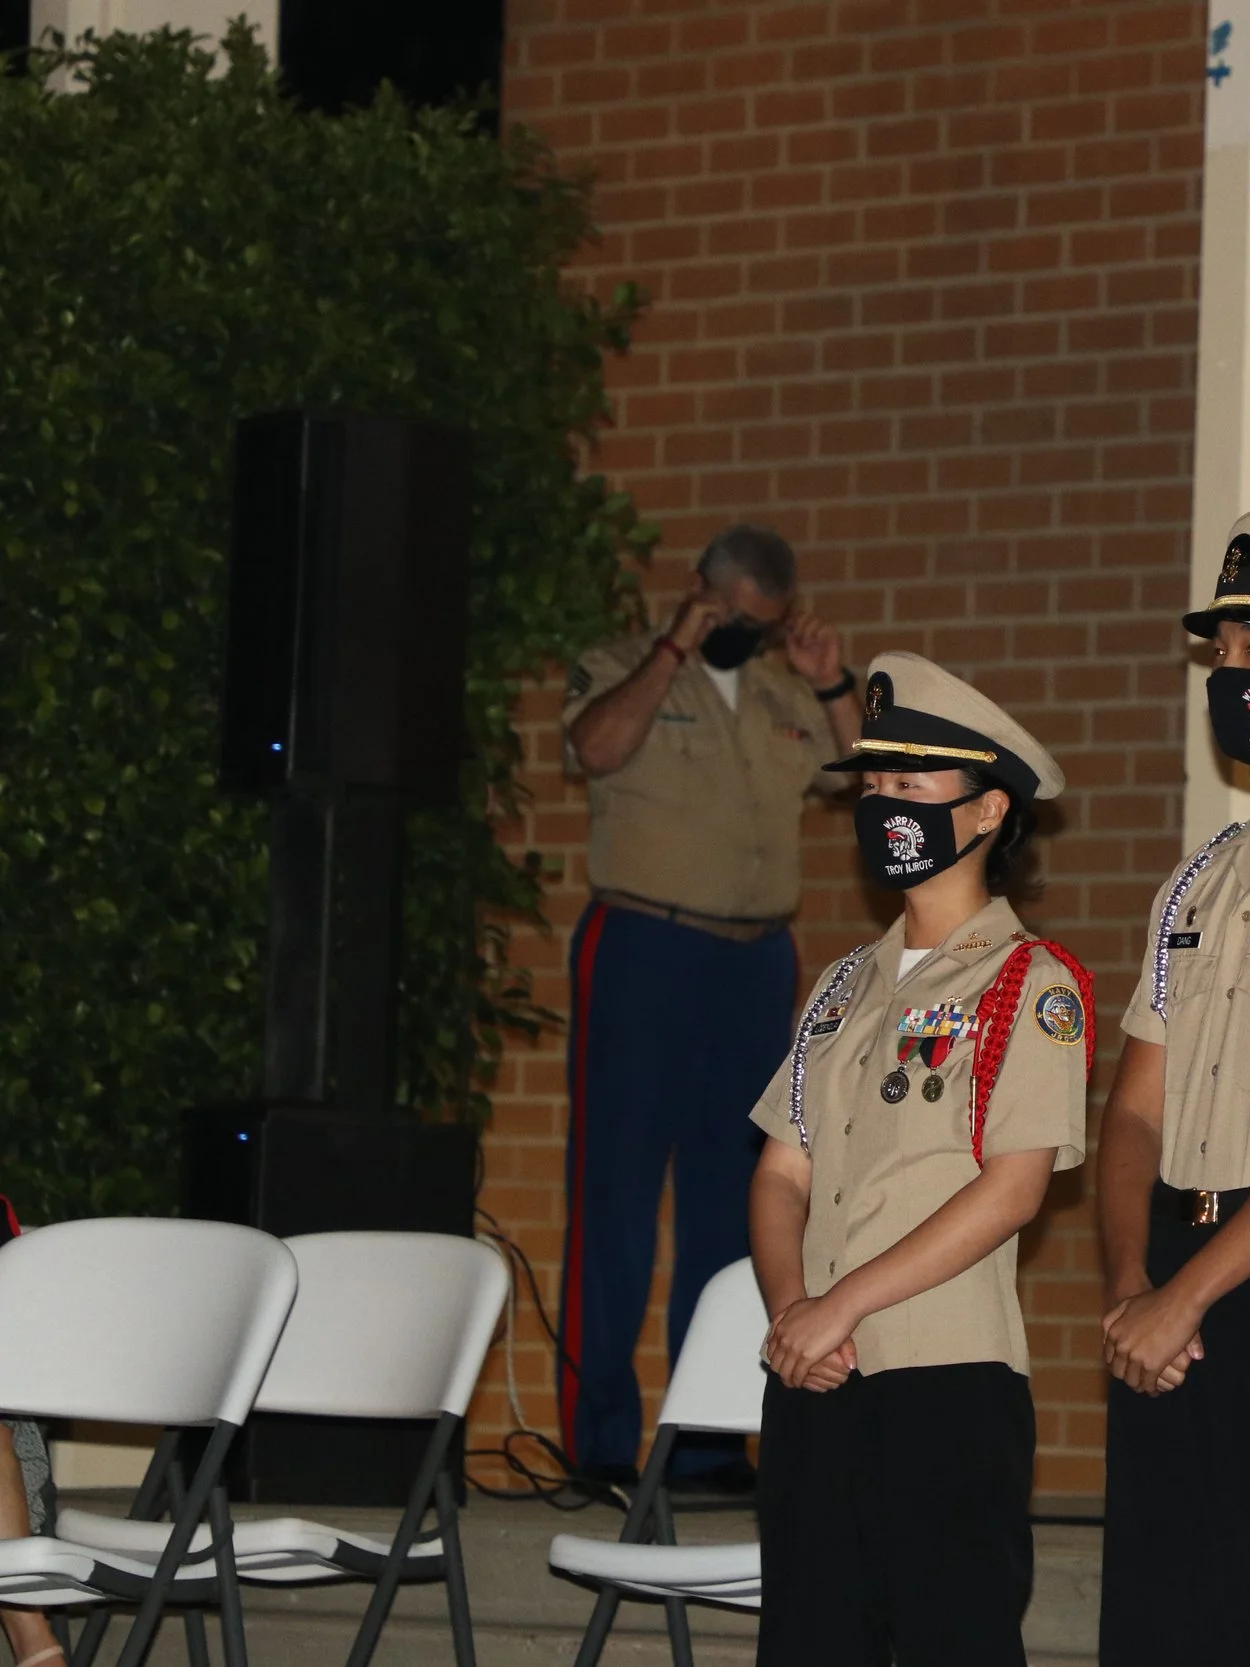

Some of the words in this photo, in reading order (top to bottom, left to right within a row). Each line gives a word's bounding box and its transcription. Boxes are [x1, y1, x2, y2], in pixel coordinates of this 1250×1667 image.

[883, 815, 925, 844] WARRIORS
[885, 864, 904, 876] TROY
[905, 858, 934, 874] NJROTC
[1176, 936, 1192, 946] DANG
[1048, 987, 1073, 997] NAVY
